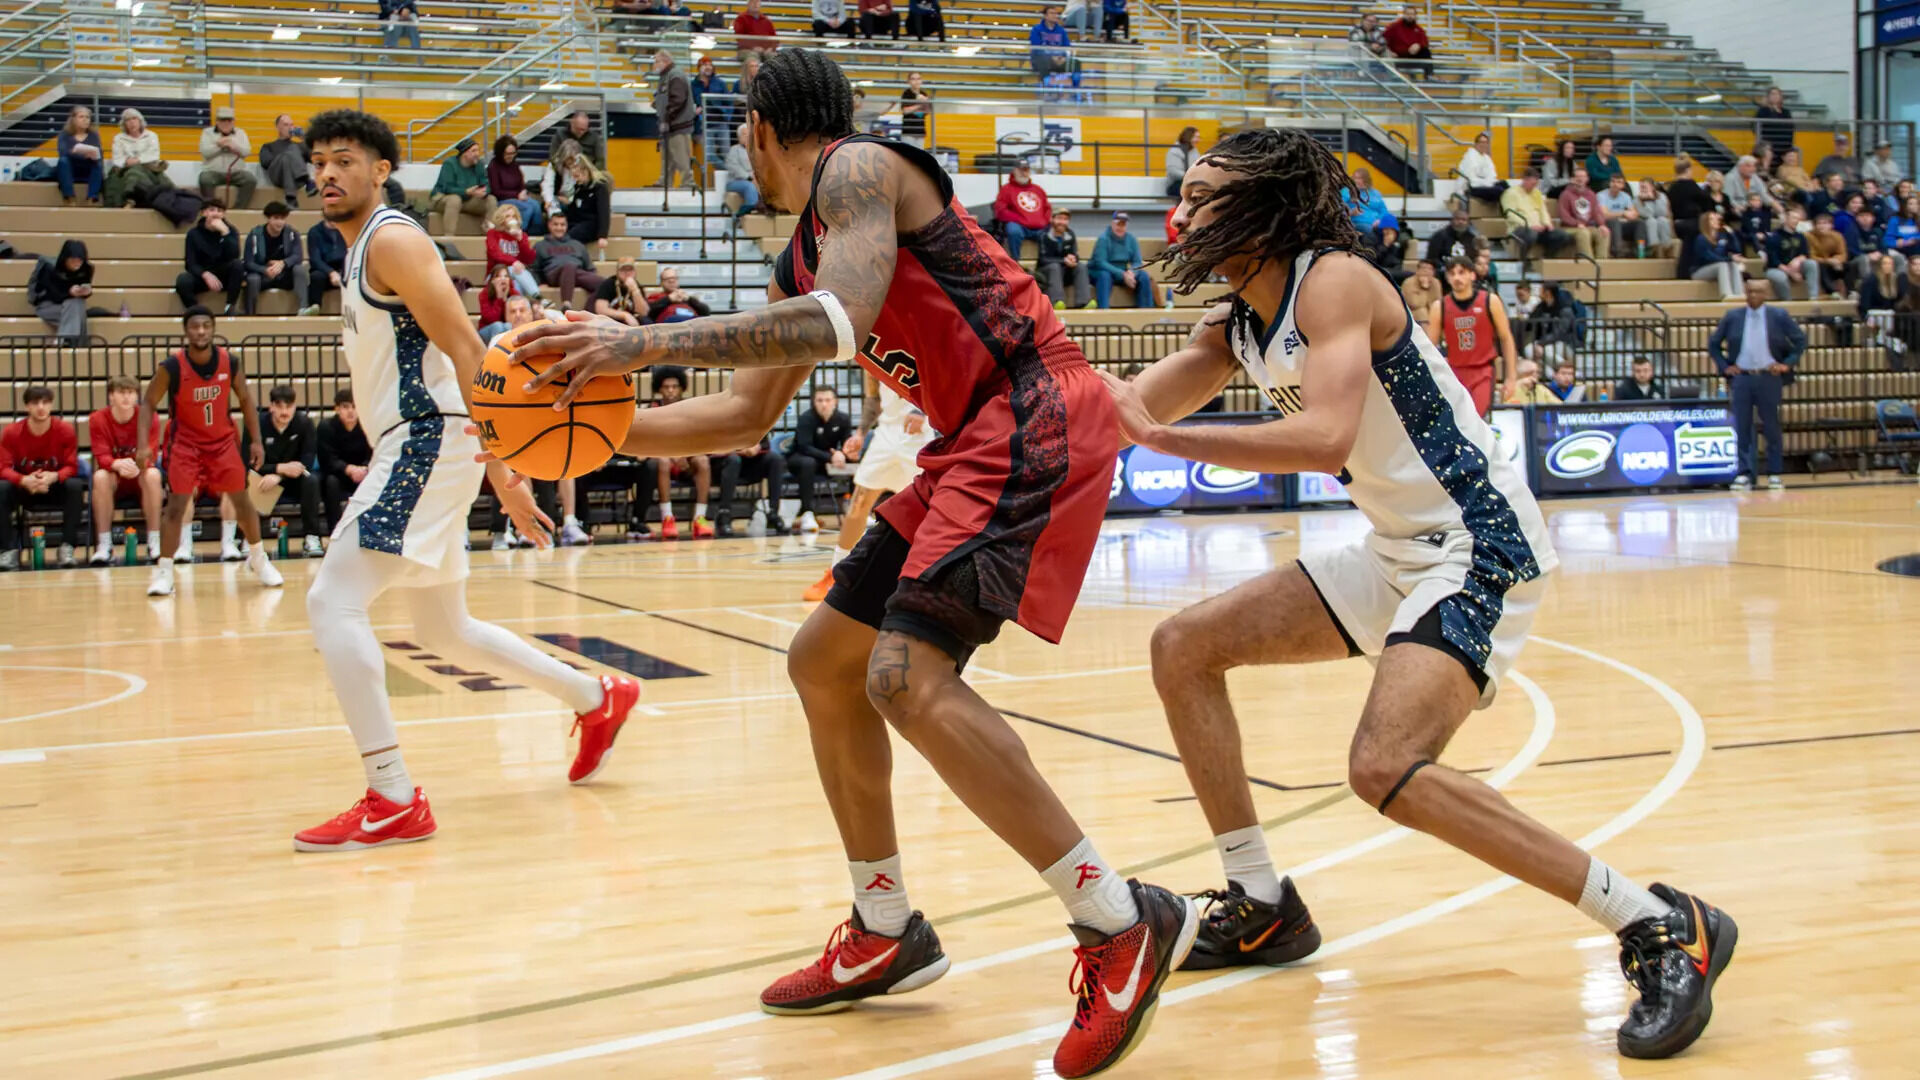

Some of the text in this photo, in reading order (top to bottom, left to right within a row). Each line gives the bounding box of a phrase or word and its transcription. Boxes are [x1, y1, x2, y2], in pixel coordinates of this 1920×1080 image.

[1458, 330, 1475, 351] 13
[859, 332, 921, 388] 5
[194, 385, 221, 401] IUP
[204, 402, 214, 427] 1
[1556, 409, 1727, 425] WWW.CLARIONGOLDENEAGLES.COM
[1679, 440, 1737, 459] PSAC
[1622, 451, 1670, 471] NCAA
[1132, 469, 1188, 491] NCAA
